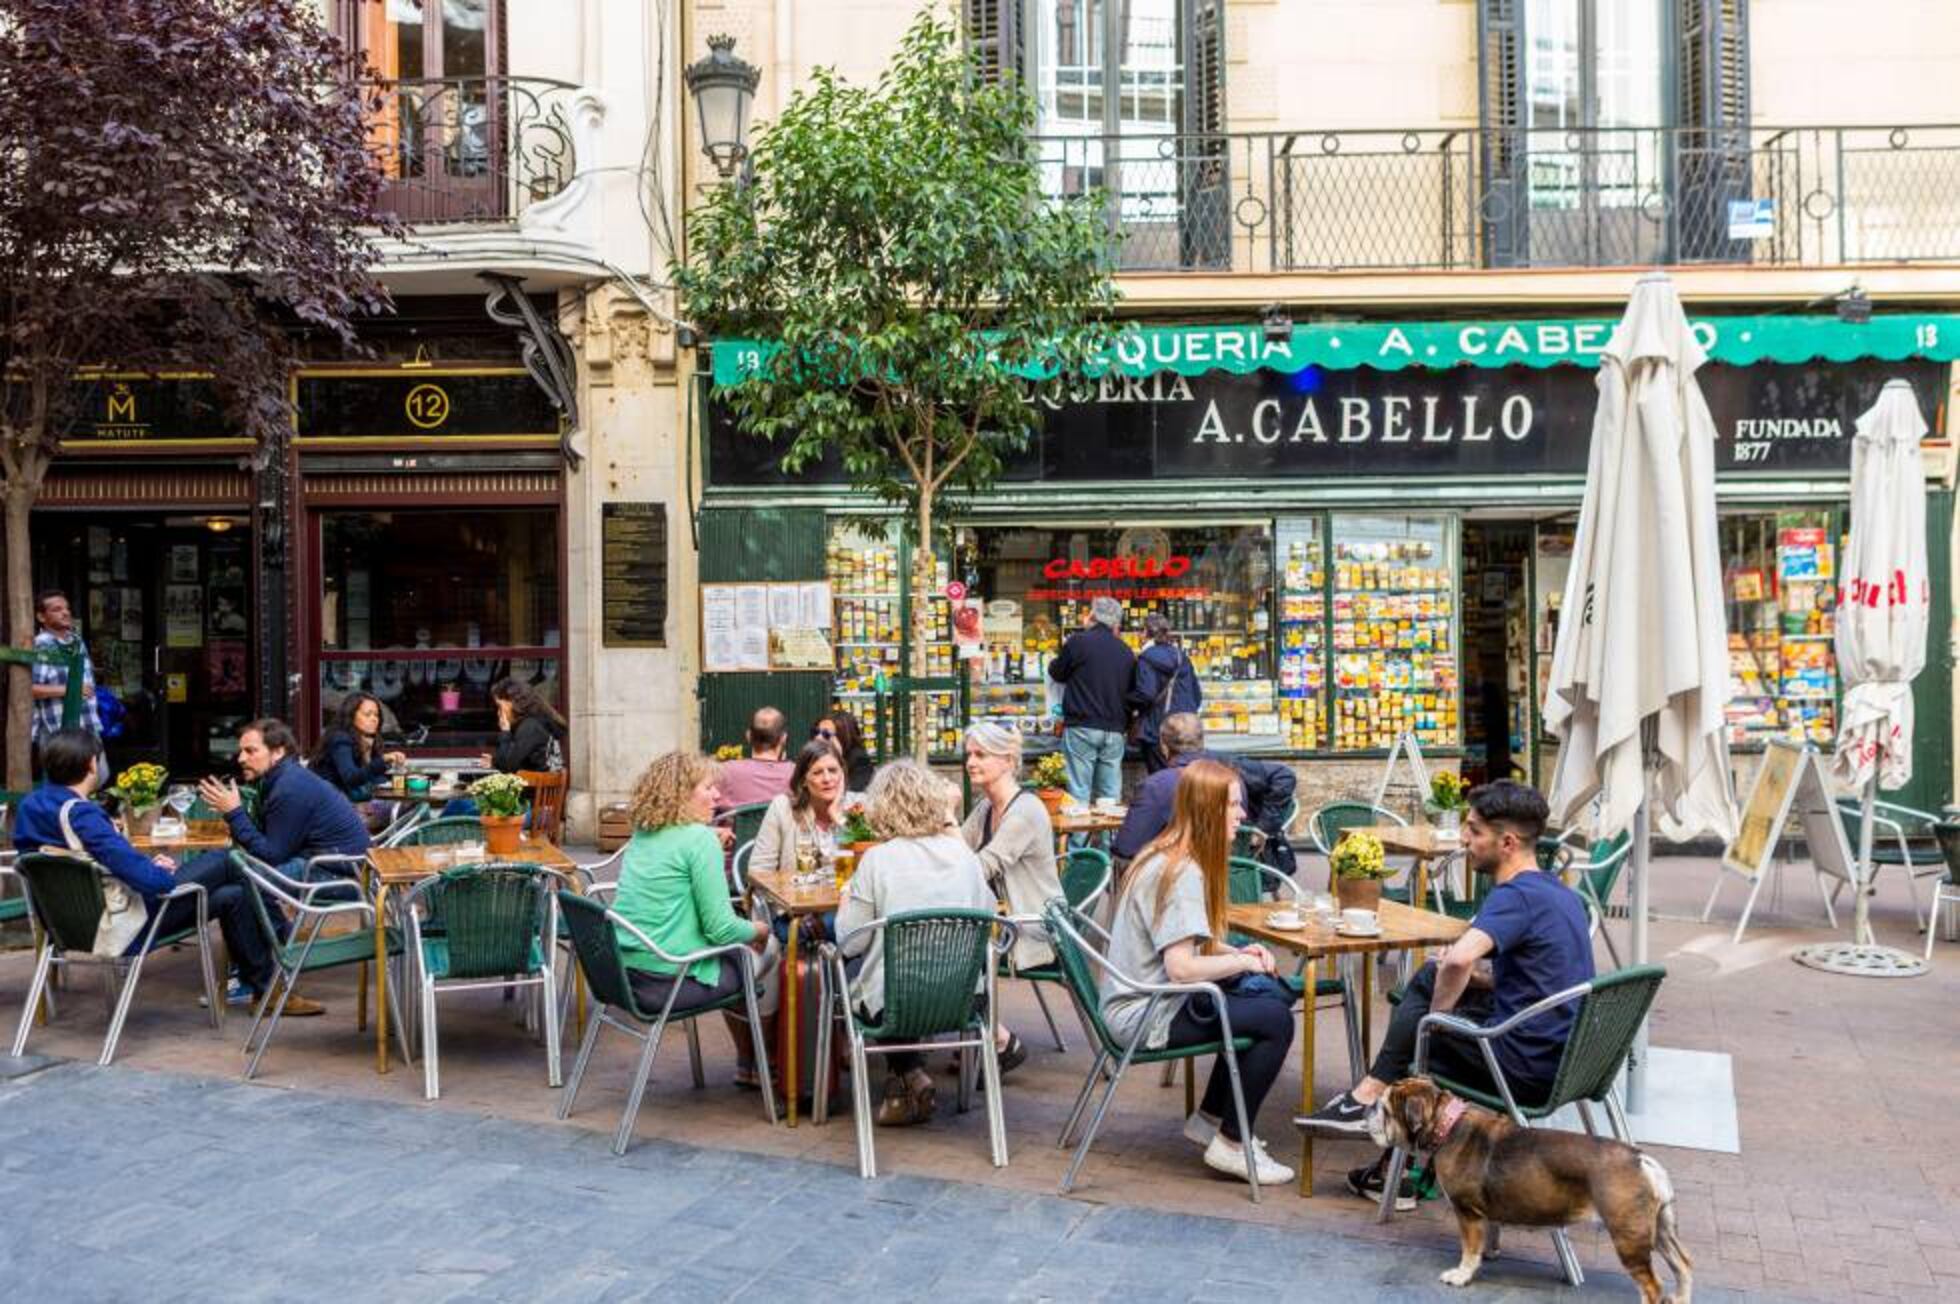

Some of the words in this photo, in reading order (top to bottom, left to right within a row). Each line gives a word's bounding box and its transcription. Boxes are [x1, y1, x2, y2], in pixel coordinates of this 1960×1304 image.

[1379, 328, 1437, 356] A.
[1458, 323, 1718, 355] CABEO
[108, 395, 135, 422] M
[411, 393, 442, 417] 12
[1735, 418, 1843, 439] FUNDADA
[1734, 441, 1771, 461] 1877
[1043, 555, 1191, 580] CABELLO
